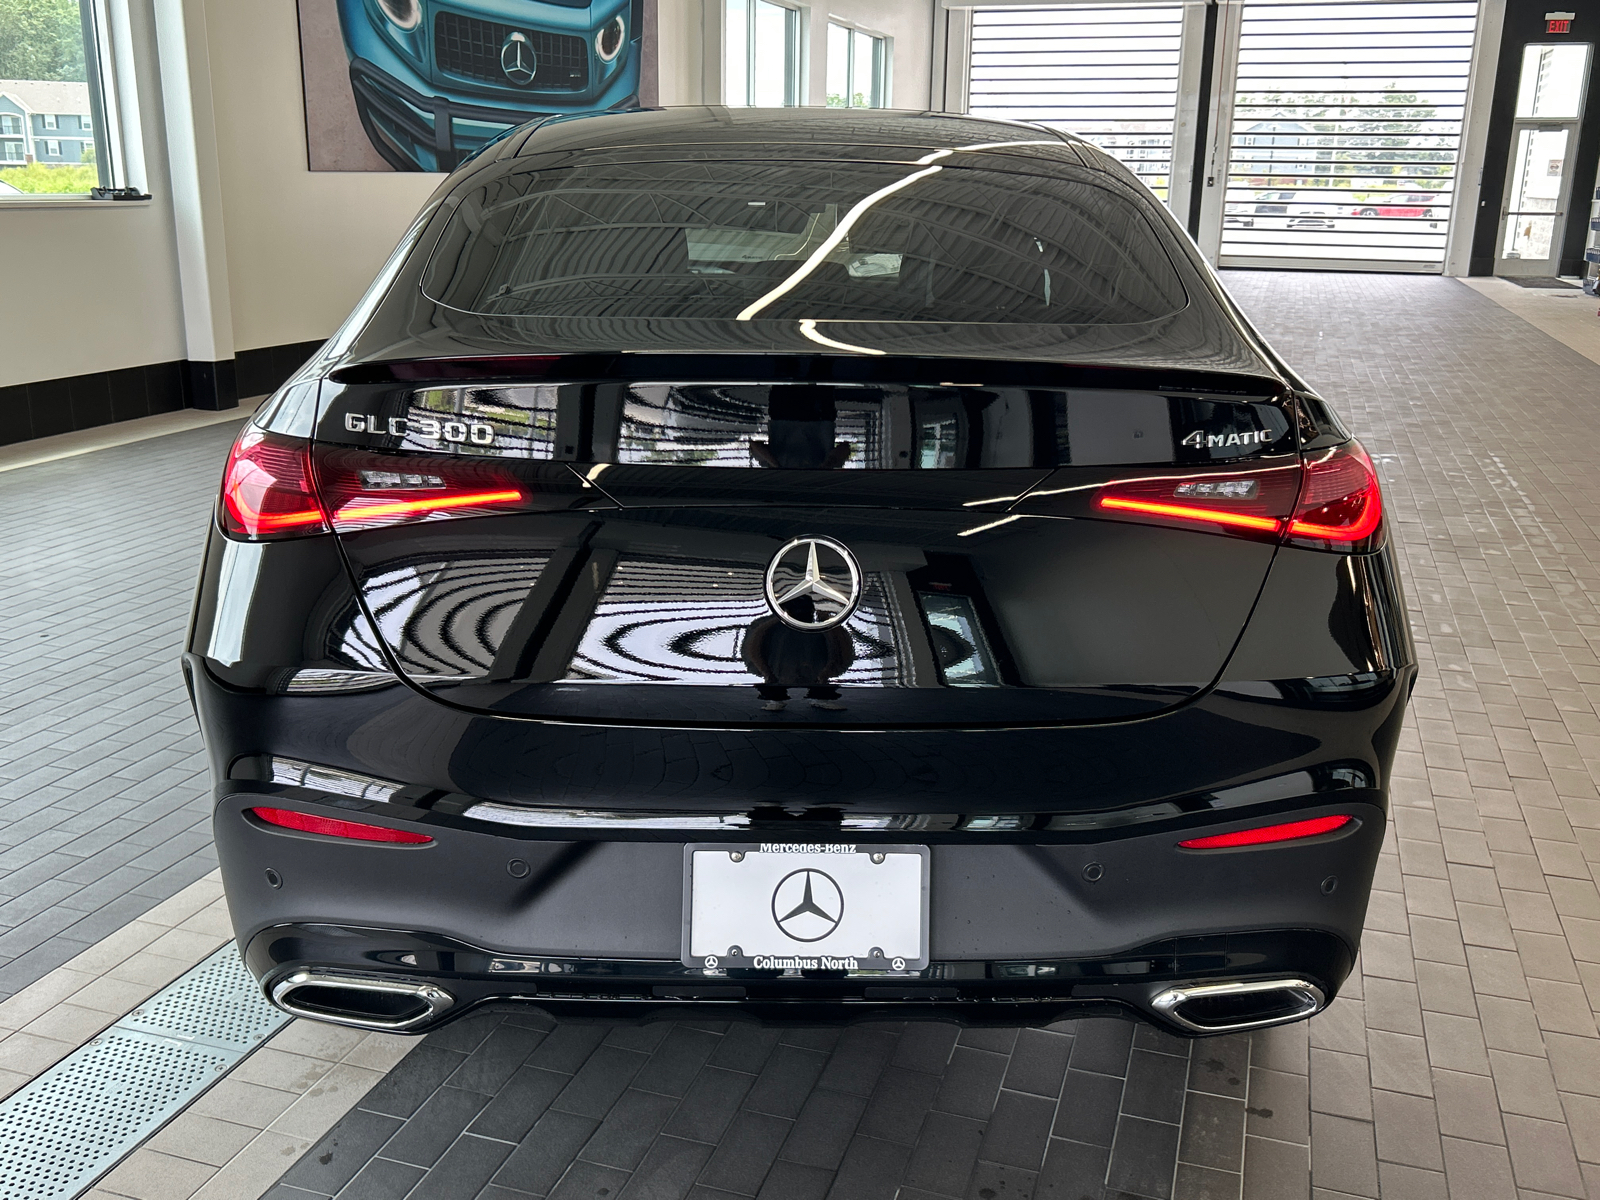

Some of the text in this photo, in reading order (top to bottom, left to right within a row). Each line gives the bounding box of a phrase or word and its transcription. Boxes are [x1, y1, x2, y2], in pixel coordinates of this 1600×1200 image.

[1548, 20, 1569, 32] EXIT
[344, 412, 495, 445] GLC 300
[1181, 429, 1273, 449] 4MATIC
[758, 842, 858, 854] Mercedes-Benz
[753, 955, 859, 971] Columbus North
